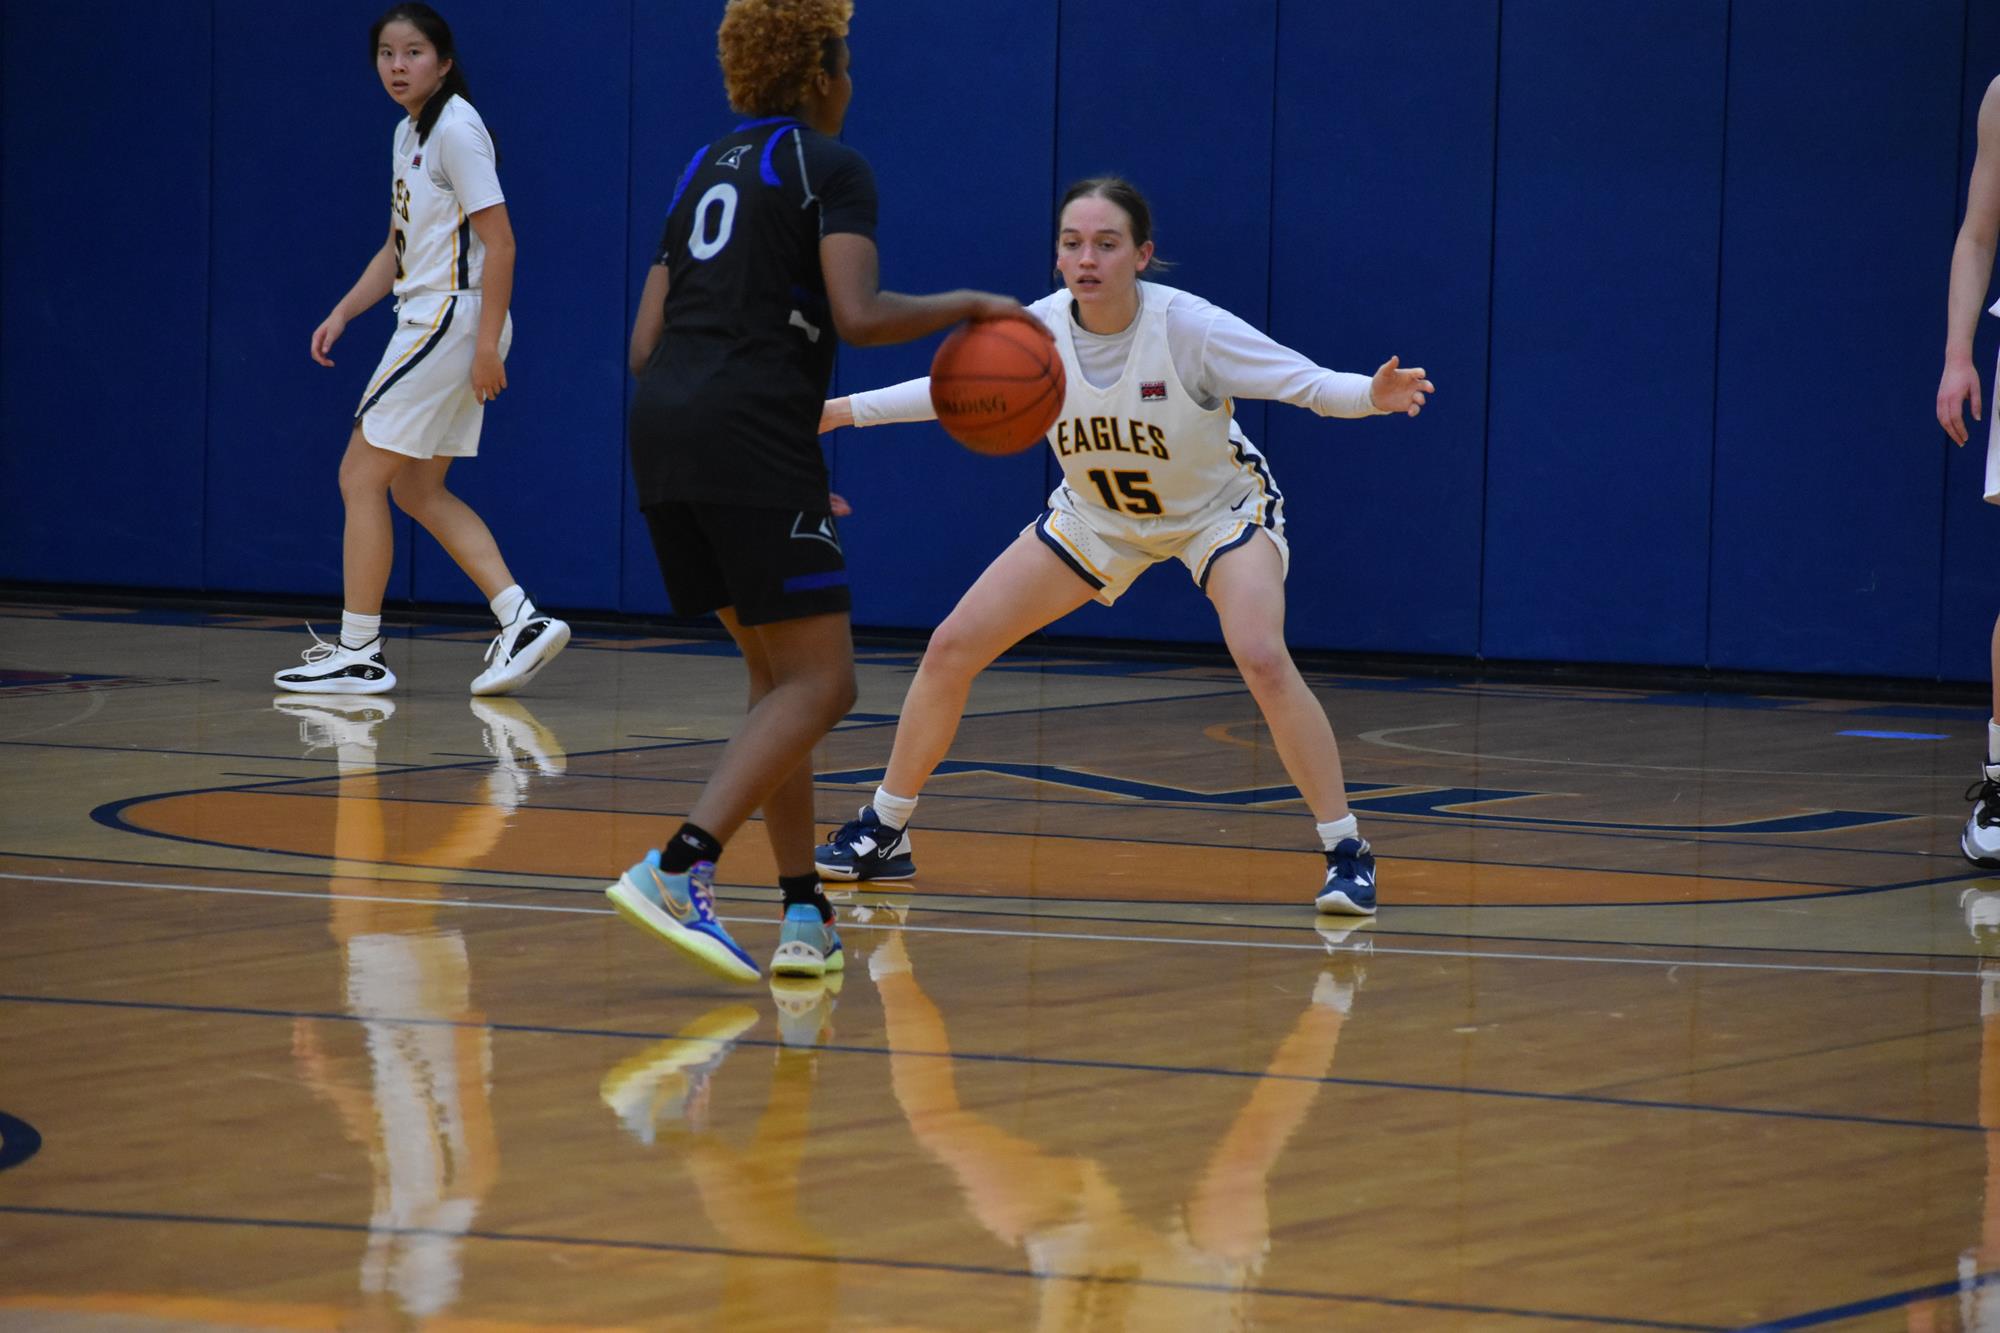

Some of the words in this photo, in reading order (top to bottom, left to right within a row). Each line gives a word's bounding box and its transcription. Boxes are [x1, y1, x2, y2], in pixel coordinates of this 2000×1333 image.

[688, 182, 739, 261] 0
[1057, 416, 1170, 461] EAGLES
[1087, 468, 1165, 518] 15
